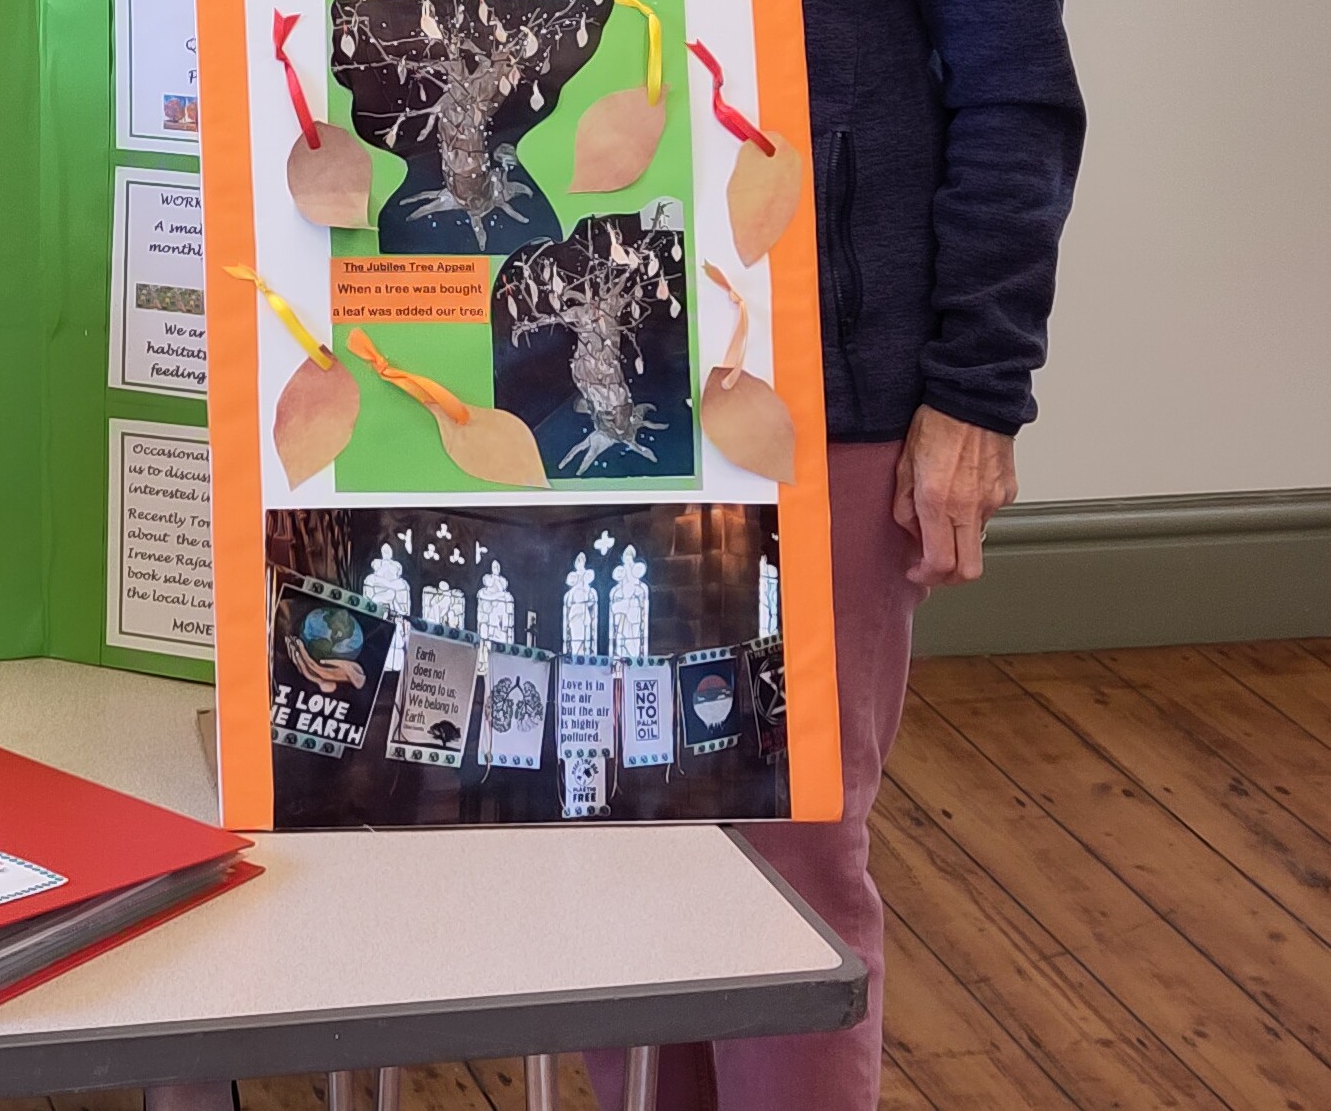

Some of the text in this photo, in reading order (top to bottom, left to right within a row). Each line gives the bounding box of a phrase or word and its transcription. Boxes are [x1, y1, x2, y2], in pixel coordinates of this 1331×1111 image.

[343, 262, 475, 274] The Jubilee Tree Appeal
[337, 283, 482, 296] When a tree was bought
[333, 308, 340, 316] a
[343, 306, 365, 316] leaf
[368, 308, 392, 317] was
[395, 306, 433, 316] added
[436, 308, 456, 316] our
[127, 508, 186, 528] Recently
[562, 679, 605, 690] Love is in
[635, 681, 657, 692] SAY
[274, 684, 350, 720] I LOVE
[561, 693, 592, 704] the air
[635, 692, 657, 705] NO
[636, 705, 657, 719] TO
[296, 712, 363, 744] EARTH
[637, 727, 658, 739] OIL
[573, 793, 597, 803] FREE
